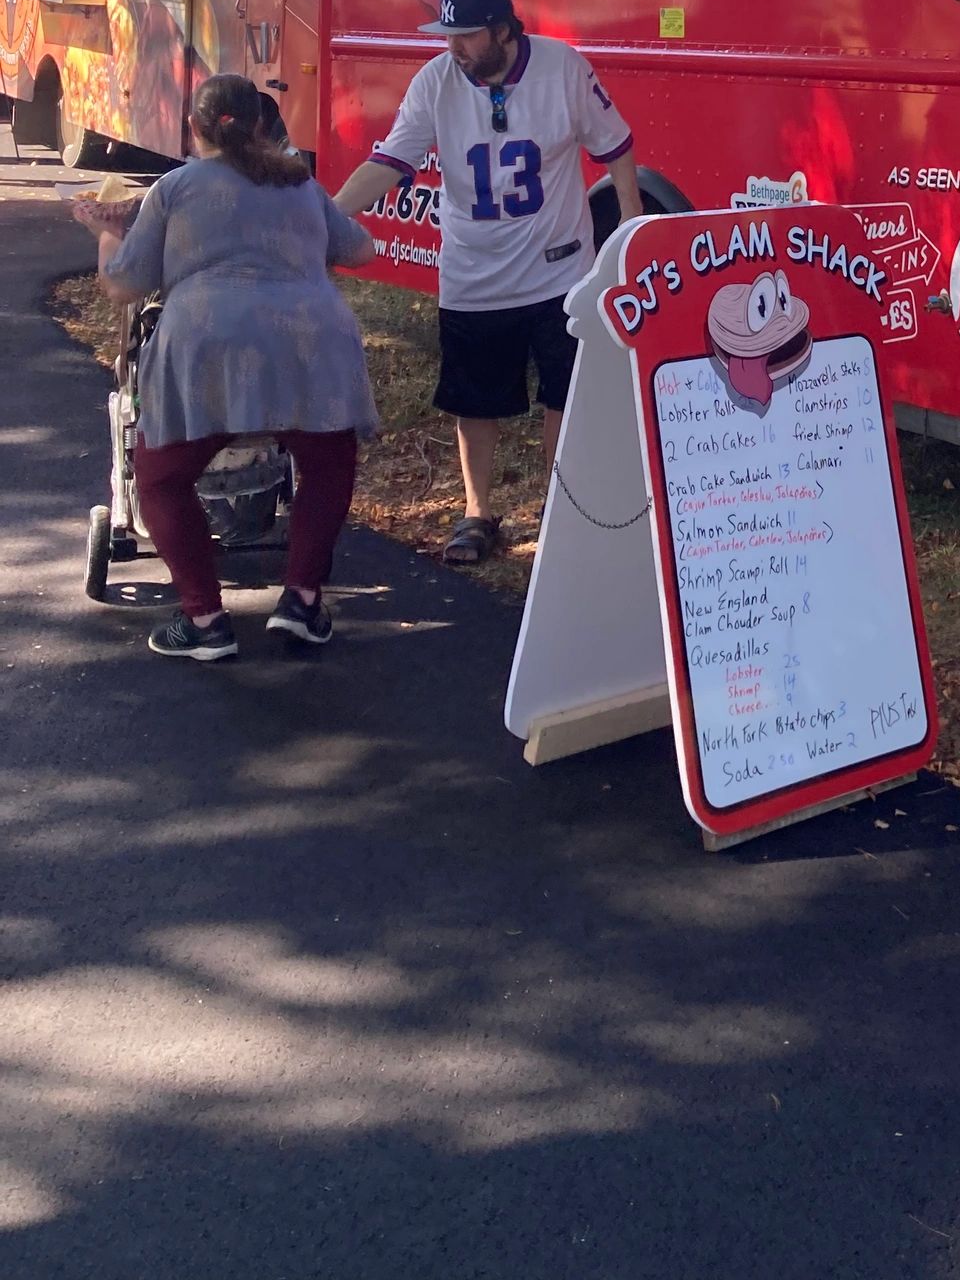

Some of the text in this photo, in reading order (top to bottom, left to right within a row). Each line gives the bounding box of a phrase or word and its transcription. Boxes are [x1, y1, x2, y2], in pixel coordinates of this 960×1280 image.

[440, 0, 456, 23] NY
[592, 82, 613, 111] 1
[466, 138, 545, 221] 13
[750, 183, 790, 203] Bethpage
[887, 166, 910, 186] AS
[915, 167, 960, 190] SEEN
[613, 221, 886, 332] DJ's CLAM SHACK
[656, 371, 681, 396] Hot
[697, 370, 721, 395] Cold
[857, 386, 873, 407] 10
[660, 400, 710, 423] Lobster
[714, 399, 736, 417] Rolls
[665, 423, 777, 463] 2 Crab Cakes 16
[797, 446, 844, 471] Calamari
[668, 463, 791, 497] Crab Cake Sandwich 13
[676, 517, 724, 543] Salmon
[727, 511, 783, 536] Sandwich
[679, 555, 808, 590] Shrimp Scampi Roll 14
[685, 585, 769, 620] New England
[685, 622, 712, 638] Clam
[770, 604, 796, 628] Soup
[802, 591, 811, 615] 8
[690, 637, 770, 669] Quesadillas
[726, 664, 764, 683] Lobster
[728, 682, 761, 699] Shrimp
[702, 726, 739, 757] North
[838, 700, 847, 718] 3
[722, 759, 764, 787] Soda
[805, 741, 842, 760] Water
